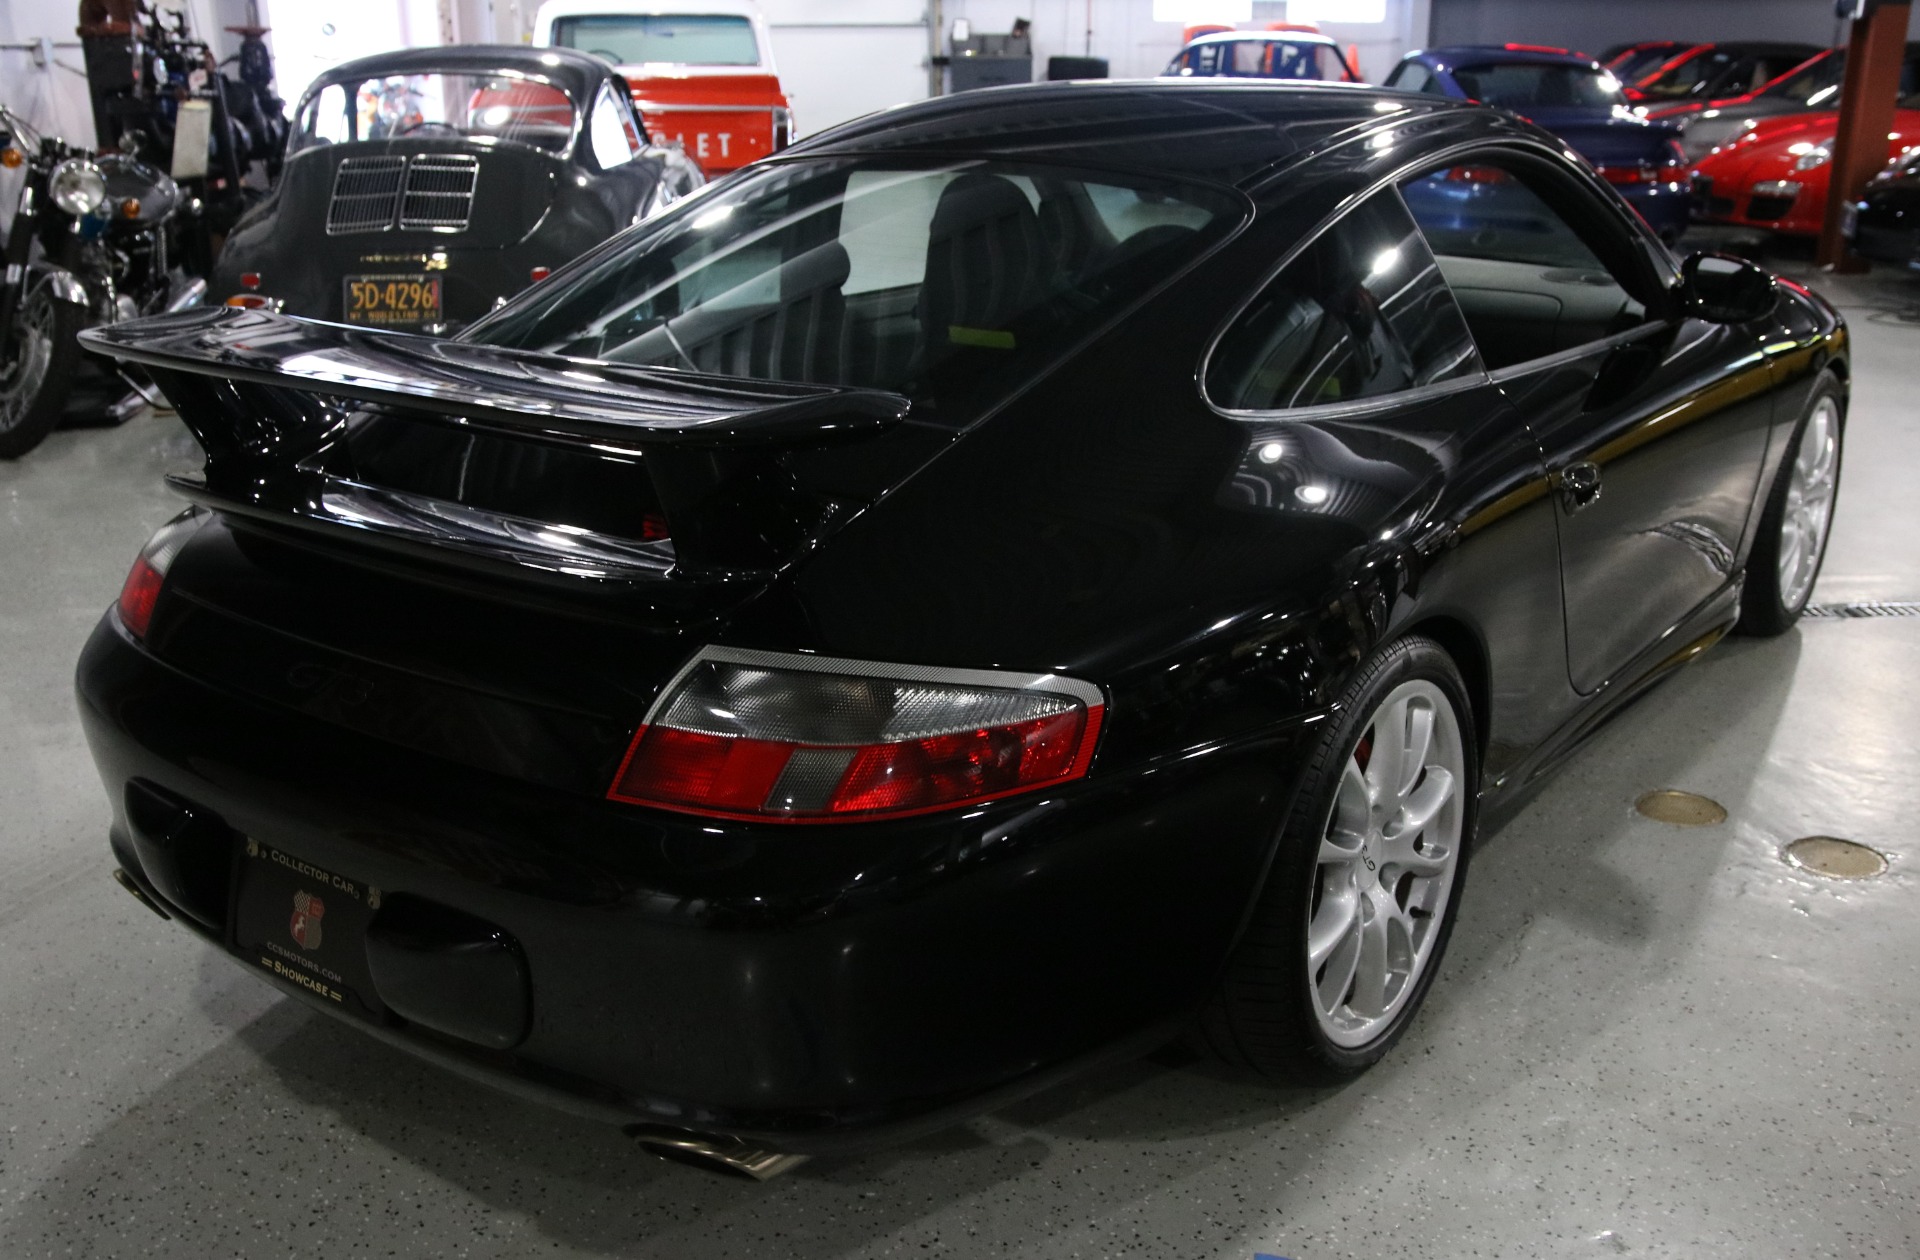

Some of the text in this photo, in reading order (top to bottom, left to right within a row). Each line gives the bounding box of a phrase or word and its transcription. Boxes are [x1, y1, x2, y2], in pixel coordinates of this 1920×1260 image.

[271, 850, 330, 884] COLLECTOR
[1361, 845, 1376, 871] GT3
[266, 941, 342, 983] CCSMOTORS.COM
[274, 960, 329, 996] SHOWCASE
